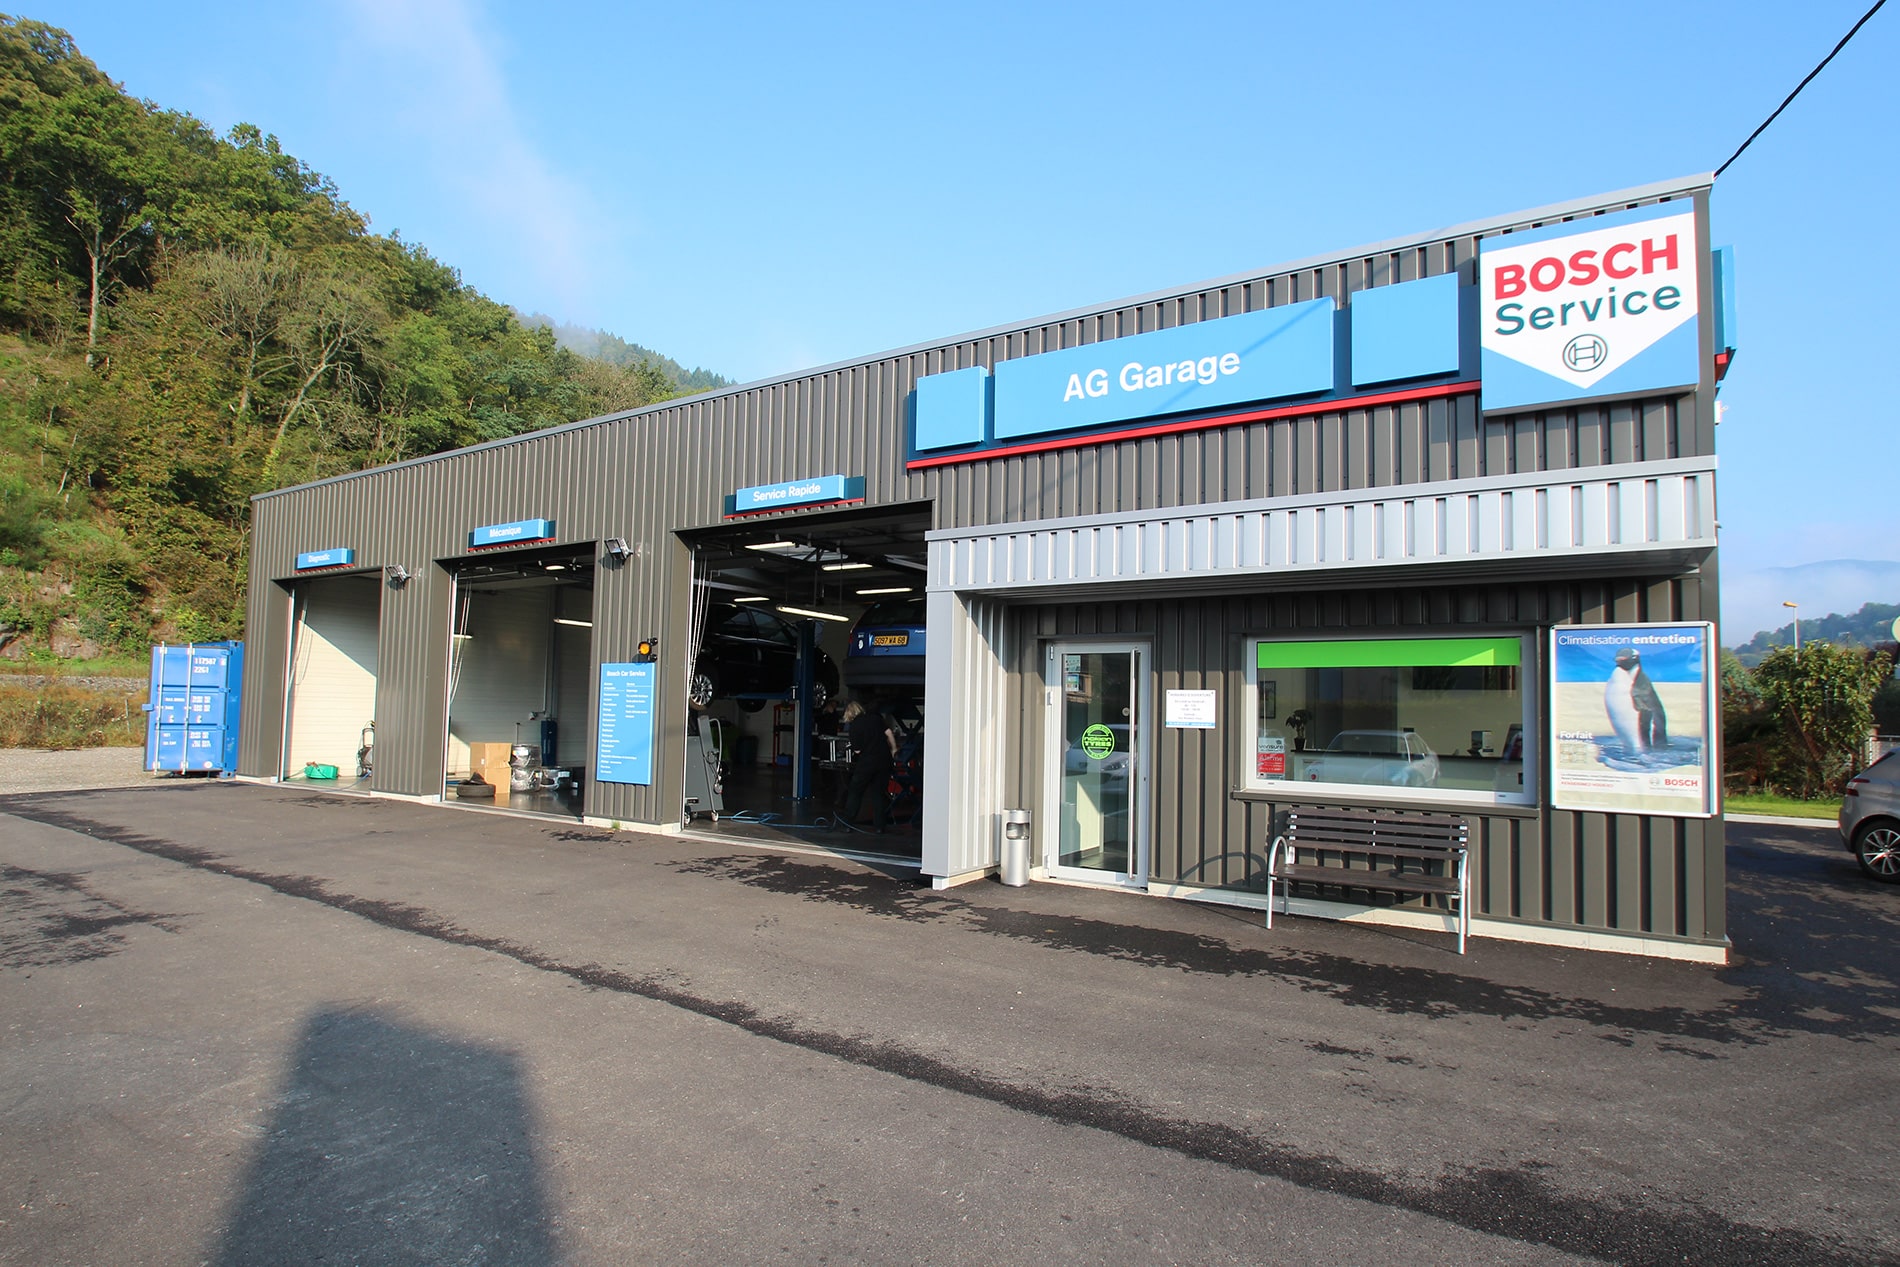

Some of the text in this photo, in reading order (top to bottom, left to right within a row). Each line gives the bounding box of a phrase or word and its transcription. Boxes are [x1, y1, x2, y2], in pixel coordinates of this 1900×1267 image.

[1494, 234, 1679, 300] BOSCH
[1494, 285, 1681, 336] Service
[1063, 352, 1241, 402] AG Garage
[753, 483, 821, 502] Service Rapide
[1558, 633, 1696, 645] Climatisation entretien
[1664, 778, 1698, 787] BOSCH
